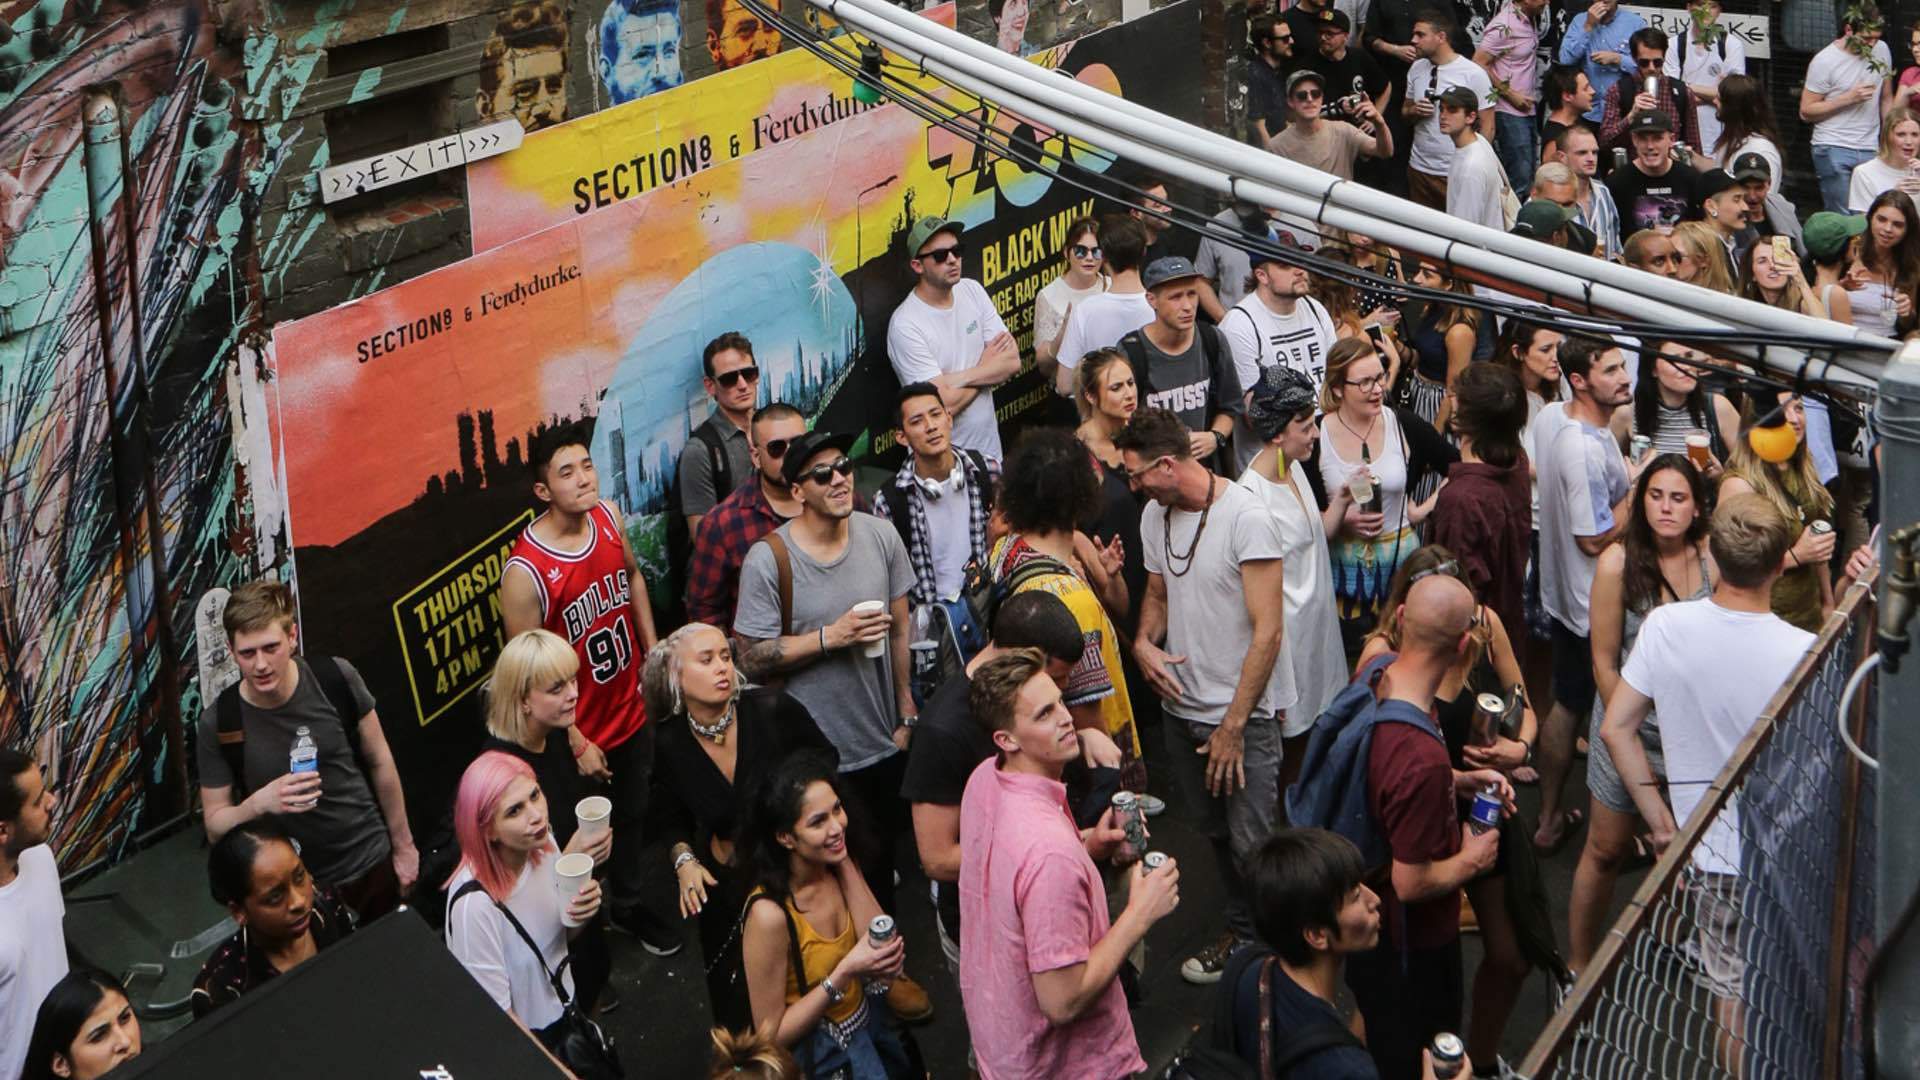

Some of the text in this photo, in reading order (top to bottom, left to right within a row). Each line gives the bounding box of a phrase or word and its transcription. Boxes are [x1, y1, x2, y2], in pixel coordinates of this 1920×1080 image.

[573, 134, 712, 215] SECTION8
[729, 134, 740, 158] &
[982, 220, 1046, 288] BLACK
[1015, 275, 1039, 307] RAP
[356, 308, 452, 364] SECTION8
[464, 306, 473, 322] &
[424, 603, 485, 667] 17TH
[562, 569, 631, 645] BULLS
[586, 614, 632, 684] 91
